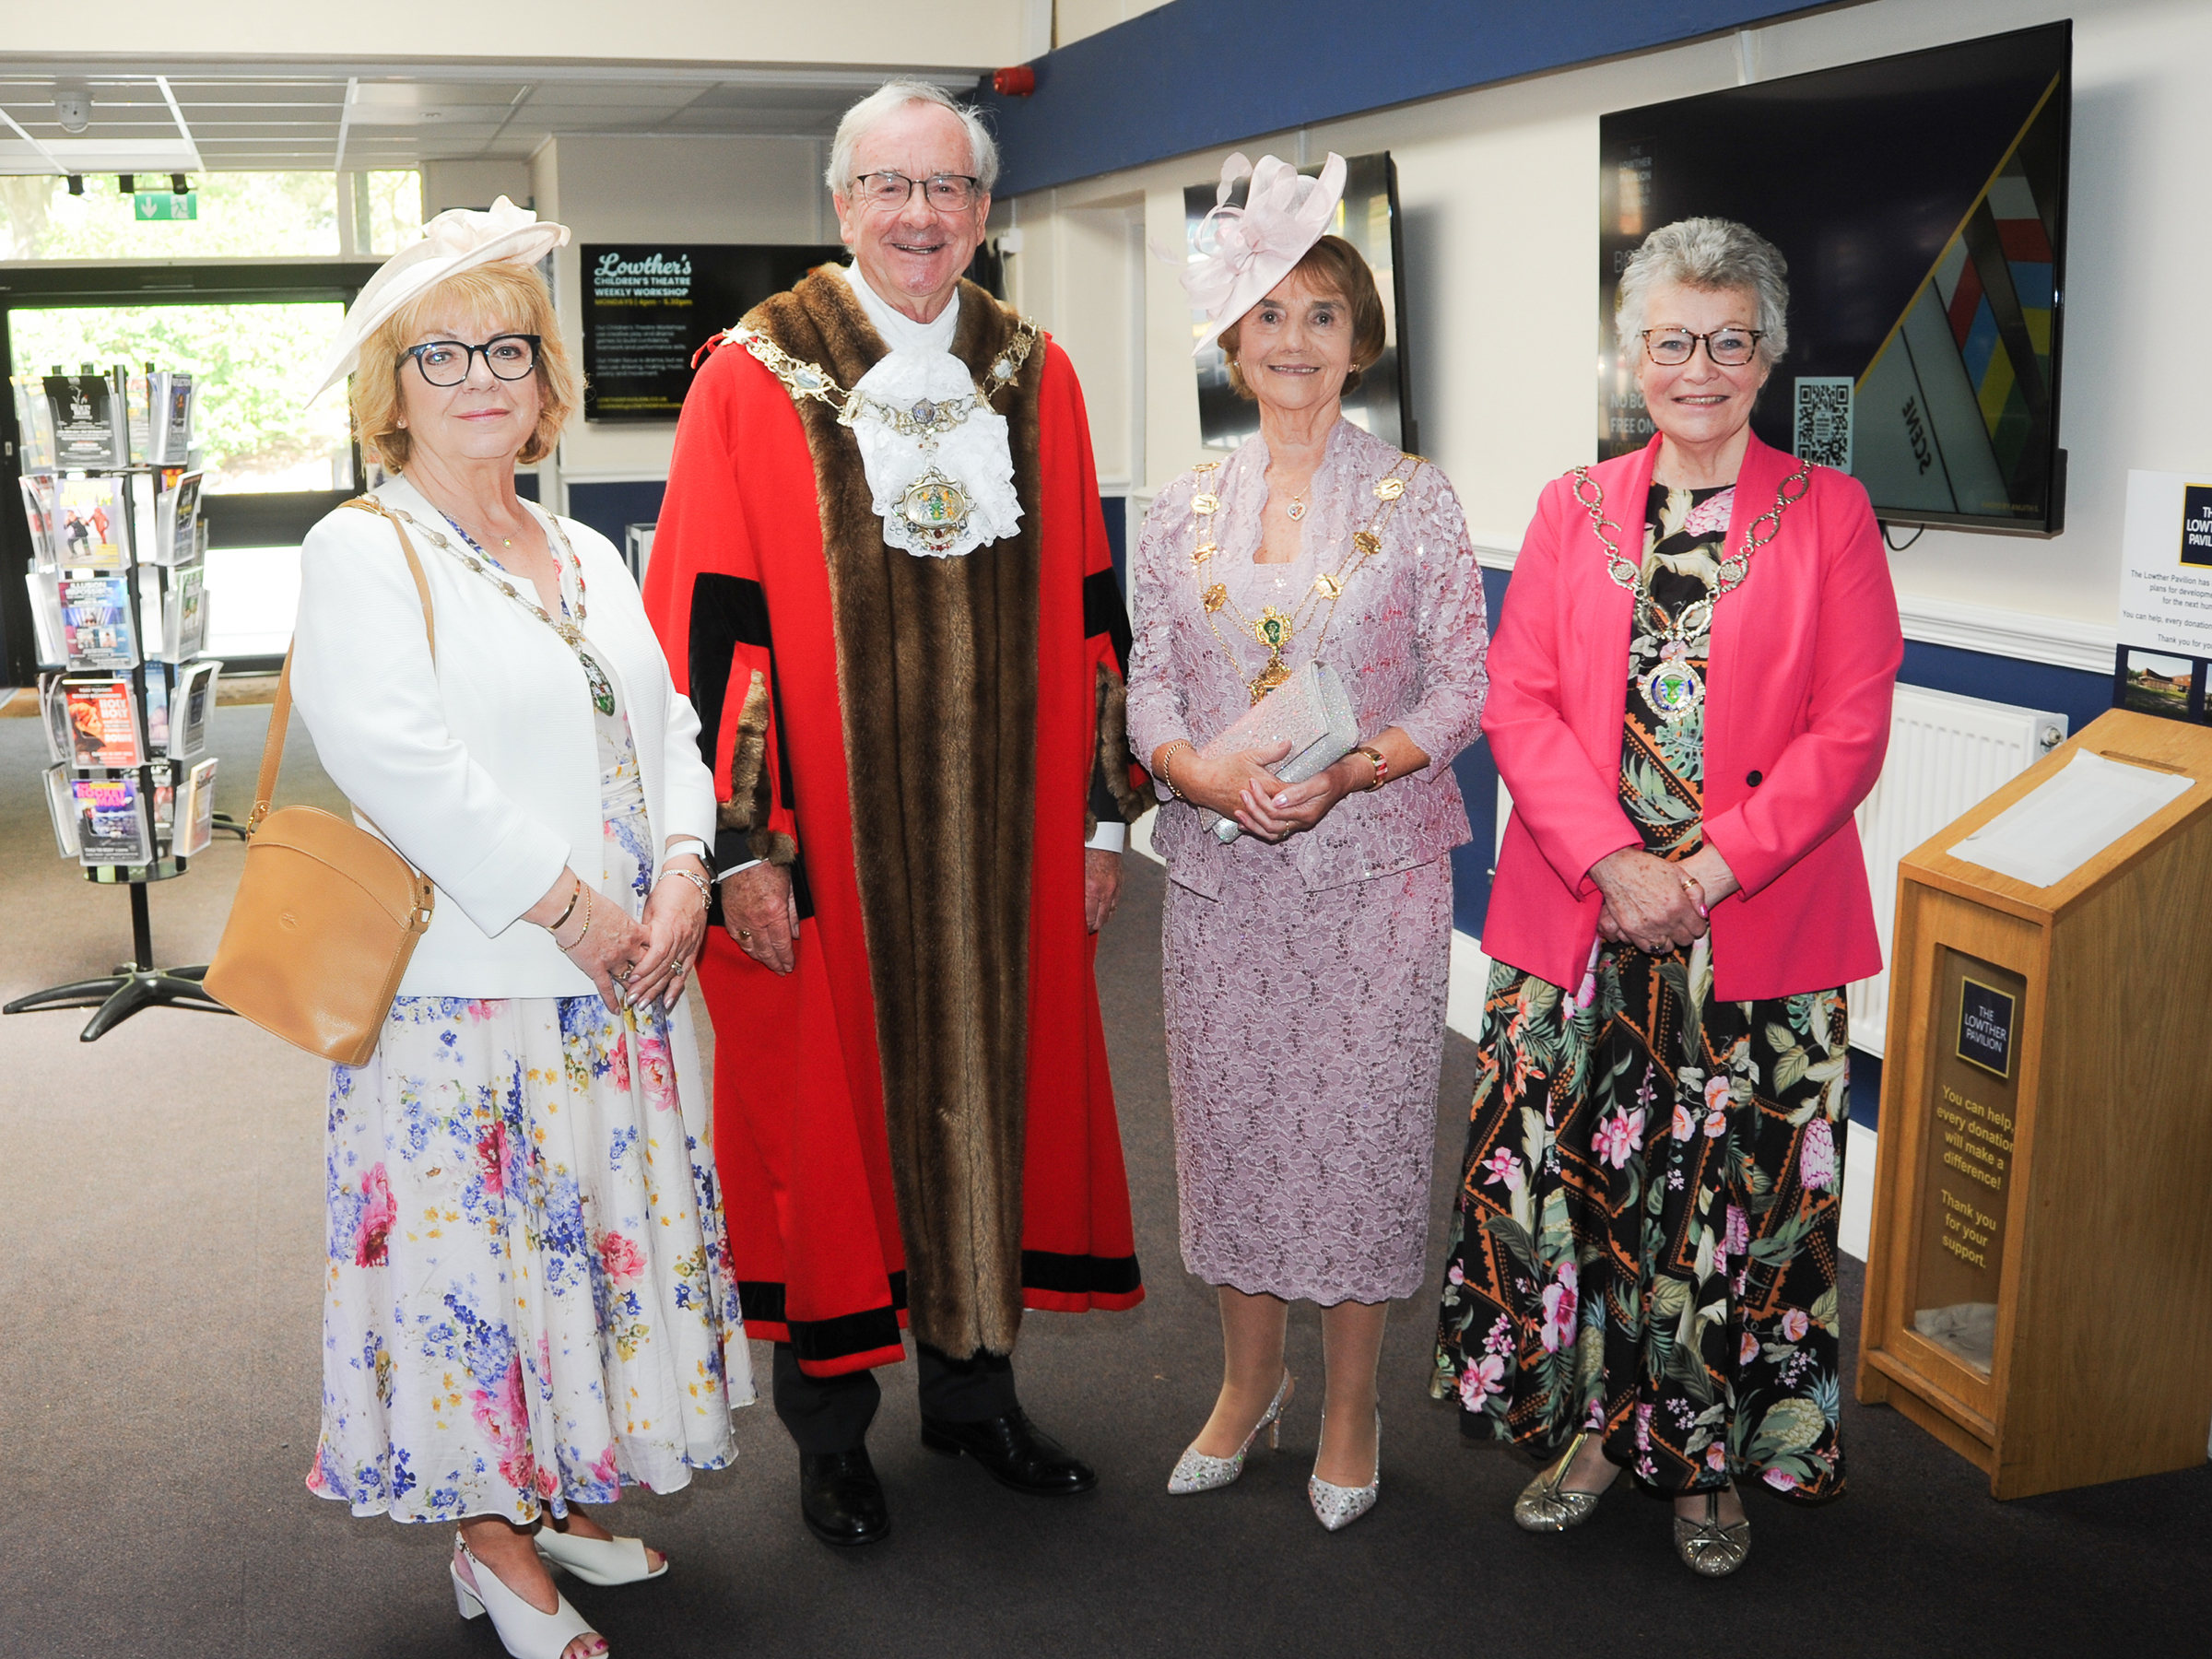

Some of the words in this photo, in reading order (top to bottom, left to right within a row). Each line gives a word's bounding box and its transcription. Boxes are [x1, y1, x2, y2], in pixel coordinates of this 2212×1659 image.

[594, 253, 692, 276] Lowther's
[594, 276, 649, 286] CHILDREN'S
[651, 276, 691, 286] THEATRE
[594, 288, 631, 296] WEEKLY
[633, 288, 688, 296] WORKSHOP
[594, 298, 633, 306] MONDAYS
[1610, 393, 1628, 408] NO
[1610, 417, 1635, 433] FREE
[2131, 570, 2142, 578] The
[2144, 572, 2170, 582] Lowther
[2171, 574, 2196, 585] Pavilion
[2198, 578, 2209, 586] has
[2149, 584, 2166, 593] plans
[2162, 596, 2171, 605] for
[2173, 598, 2183, 606] the
[2123, 610, 2134, 618] You
[2165, 618, 2183, 628] every
[2158, 633, 2176, 643] Thank
[2178, 638, 2191, 646] you
[99, 699, 127, 709] HOLY
[100, 708, 128, 719] HOLY
[76, 788, 126, 798] ROCKET
[96, 795, 126, 806] MAN
[1979, 1006, 1994, 1022] THE
[1964, 1013, 2006, 1041] LOWTHER
[1966, 1028, 2003, 1053] PAVILION
[1943, 1085, 1962, 1106] You
[1965, 1100, 1985, 1117] can
[1987, 1106, 2014, 1134] help,
[1936, 1107, 1966, 1131] every
[1945, 1132, 1963, 1149] will
[1965, 1142, 1994, 1165] make
[1996, 1159, 2005, 1171] a
[1944, 1151, 2002, 1190] difference!
[1941, 1189, 1974, 1218] Thank
[1975, 1211, 1996, 1231] you
[1946, 1213, 1961, 1231] for
[1961, 1225, 1989, 1247] your
[1942, 1235, 1986, 1268] support.
